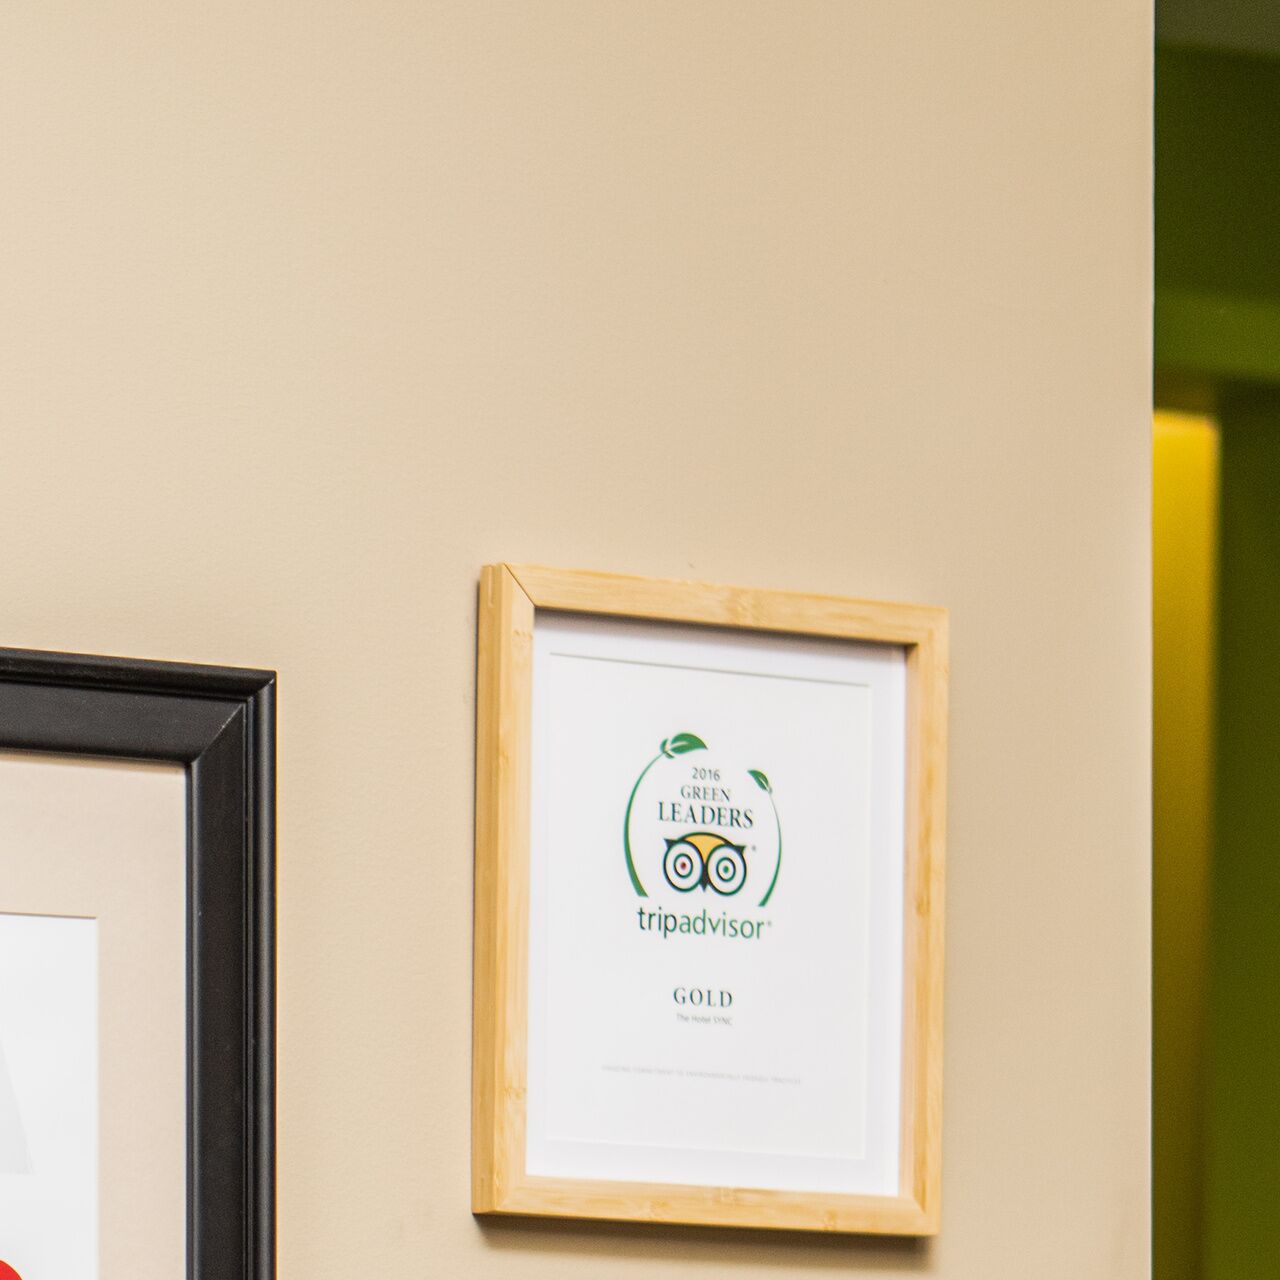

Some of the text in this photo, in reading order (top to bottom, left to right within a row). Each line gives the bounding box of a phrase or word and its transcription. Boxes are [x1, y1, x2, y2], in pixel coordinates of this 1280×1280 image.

[692, 767, 720, 782] 2016
[680, 784, 732, 802] GREEN
[658, 801, 754, 829] LEADERS
[637, 906, 765, 940] tripadvisor
[673, 987, 733, 1008] GOLD
